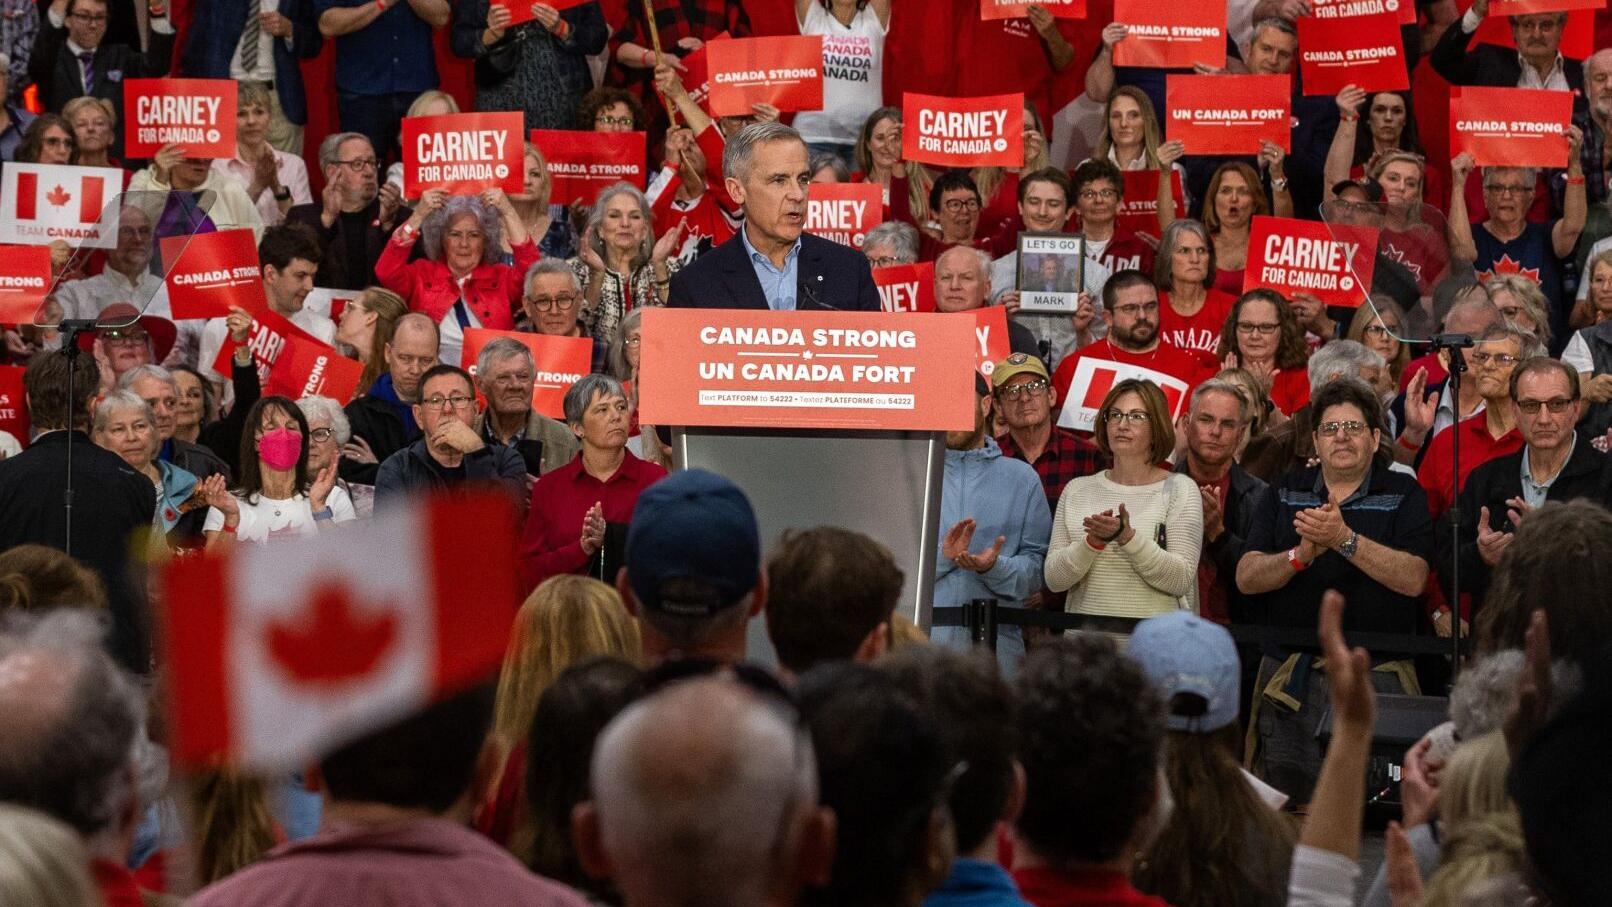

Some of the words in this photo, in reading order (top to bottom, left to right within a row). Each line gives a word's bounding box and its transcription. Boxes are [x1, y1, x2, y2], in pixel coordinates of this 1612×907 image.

[1315, 5, 1337, 18] FOR
[1338, 0, 1385, 17] CANADA
[1124, 24, 1169, 35] ANADA
[1171, 26, 1220, 37] STRONG
[823, 34, 870, 46] ANADA
[822, 44, 872, 57] ANADA
[1303, 51, 1344, 61] CANADA
[1345, 46, 1397, 60] STRONG
[822, 53, 871, 70] ANADA
[714, 70, 766, 83] CANADA
[768, 68, 817, 80] STRONG
[822, 65, 869, 83] NADA
[136, 95, 222, 126] CARNEY
[1172, 109, 1192, 120] UN
[1194, 109, 1248, 120] CANADA
[1251, 109, 1285, 120] FORT
[919, 108, 1008, 138] CARNEY
[1456, 120, 1507, 131] CANADA
[1510, 121, 1563, 133] STRONG
[138, 128, 157, 144] FOR
[158, 127, 205, 144] CANADA
[417, 129, 507, 164] CARNEY
[918, 136, 941, 152] FOR
[943, 139, 992, 155] CANADA
[418, 165, 440, 183] FOR
[443, 164, 493, 181] CANADA
[546, 162, 587, 174] ANADA
[589, 164, 639, 175] STRONG
[802, 199, 867, 230] RNEY
[16, 224, 44, 236] TEAM
[46, 227, 100, 239] CANADA
[1027, 239, 1056, 249] LET'S
[1059, 240, 1076, 250] GO
[1264, 234, 1360, 273] CARNEY
[0, 276, 44, 287] TRONG
[173, 269, 231, 285] CANADA
[232, 266, 260, 279] STRONG
[1261, 266, 1286, 285] FOR
[1288, 269, 1337, 290] CANADA
[877, 281, 919, 313] NEY
[1033, 295, 1065, 306] MARK
[700, 326, 806, 346] CANADA
[812, 328, 917, 348] STRONG
[1162, 327, 1222, 355] ANADA
[301, 355, 328, 399] TRONG
[536, 371, 582, 384] TRONG
[698, 362, 735, 380] UN
[741, 362, 845, 382] CANADA
[852, 365, 916, 383] FORT
[701, 394, 716, 402] Text
[717, 394, 758, 402] PLATFORM
[825, 396, 874, 404] PLATEFORME
[888, 397, 912, 405] 54222
